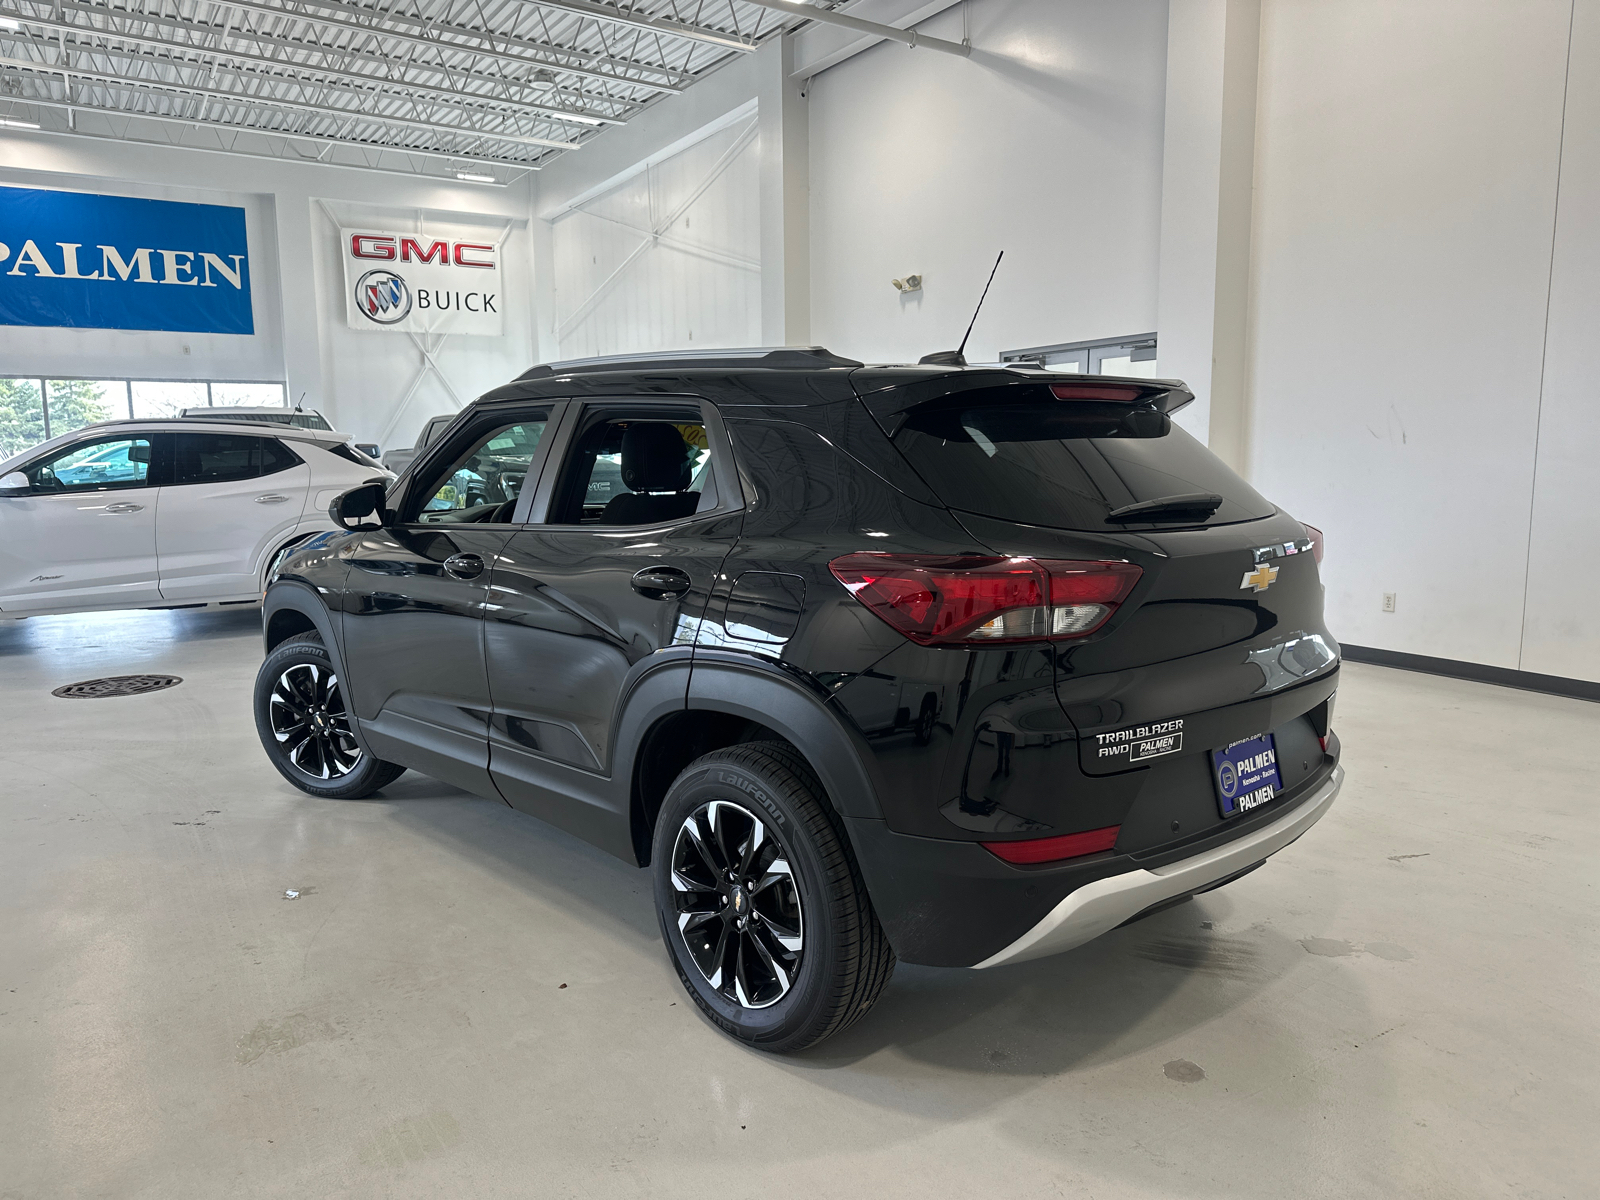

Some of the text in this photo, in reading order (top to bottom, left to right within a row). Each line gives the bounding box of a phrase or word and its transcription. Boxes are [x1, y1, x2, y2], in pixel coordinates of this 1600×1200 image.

[350, 232, 496, 270] GMC
[417, 289, 498, 313] BUICK
[1096, 719, 1184, 745] TRAILBLAZER
[1140, 736, 1175, 752] PALMEN
[1228, 732, 1262, 749] palmen.com
[1098, 744, 1129, 758] AWD
[1237, 748, 1275, 777] PALMEN
[1239, 784, 1275, 813] PALMEN
